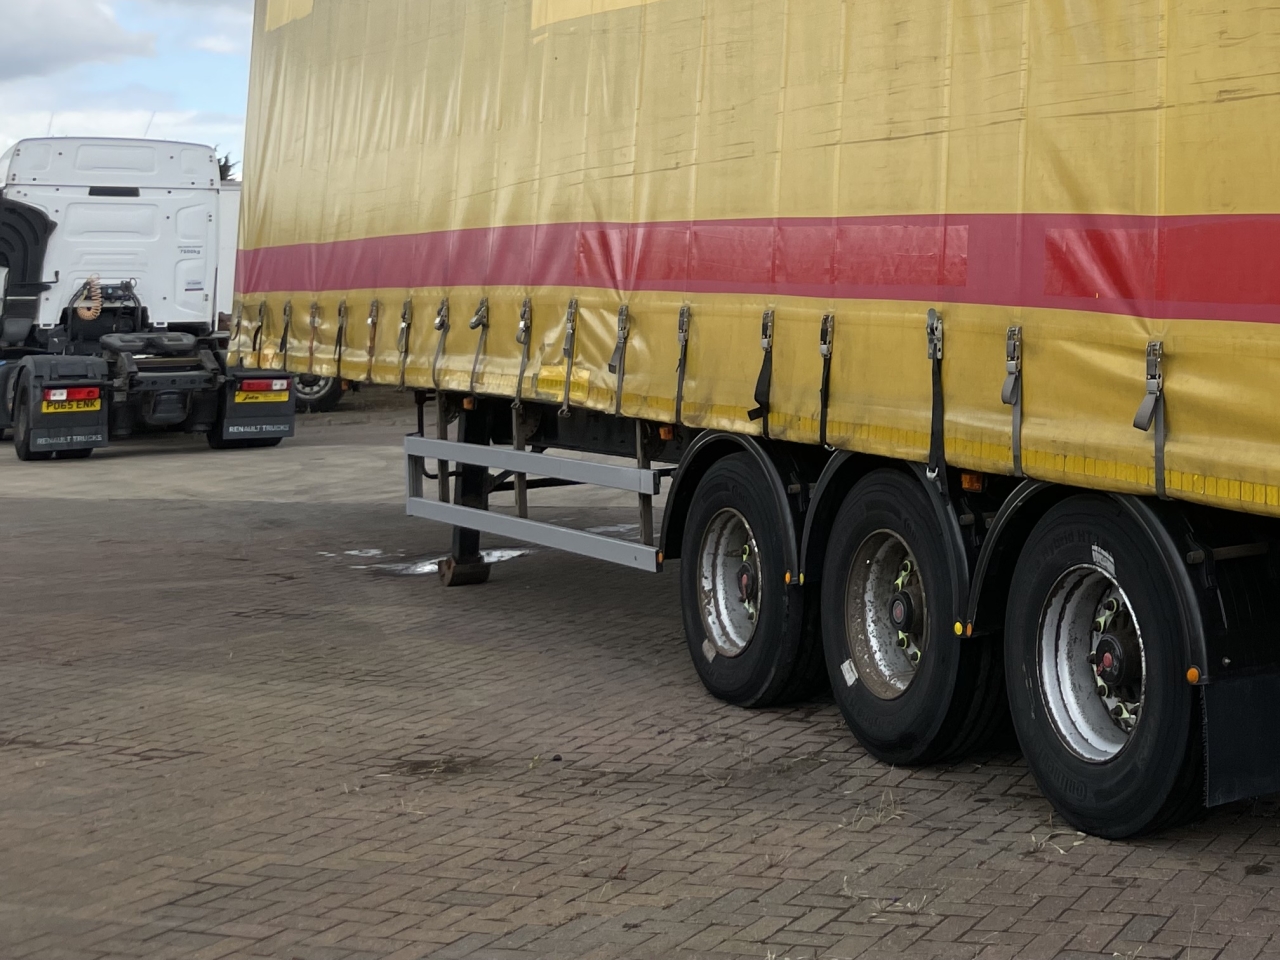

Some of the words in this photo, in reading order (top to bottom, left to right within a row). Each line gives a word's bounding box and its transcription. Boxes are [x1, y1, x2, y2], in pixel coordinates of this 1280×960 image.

[76, 400, 97, 409] ENK
[228, 425, 261, 433] RENAULT
[36, 435, 71, 444] RENAULT
[72, 434, 103, 442] TRUCKS
